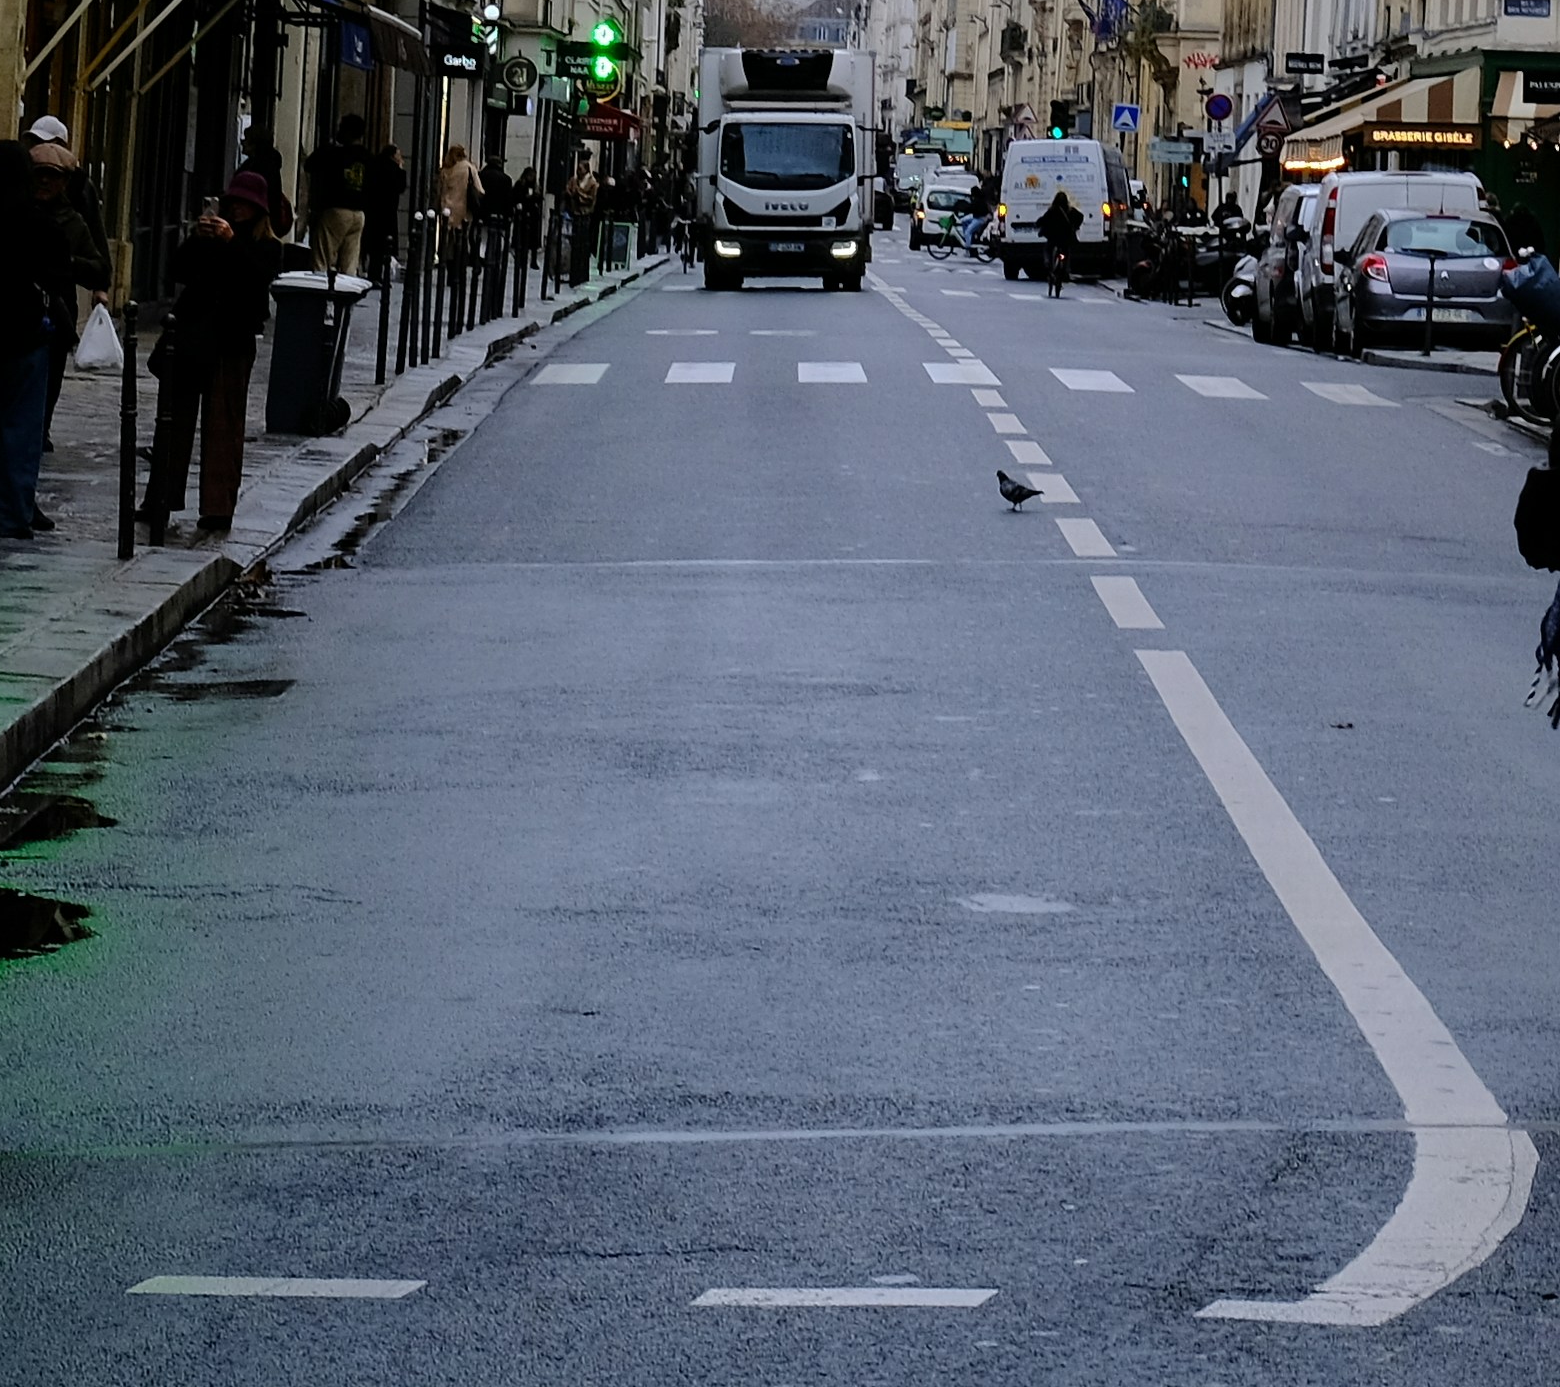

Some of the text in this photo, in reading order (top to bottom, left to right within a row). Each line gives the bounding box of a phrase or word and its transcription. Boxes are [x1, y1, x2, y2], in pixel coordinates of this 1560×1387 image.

[1372, 130, 1433, 143] BRASSERIE
[1263, 138, 1278, 151] 30
[765, 202, 809, 211] IVECO
